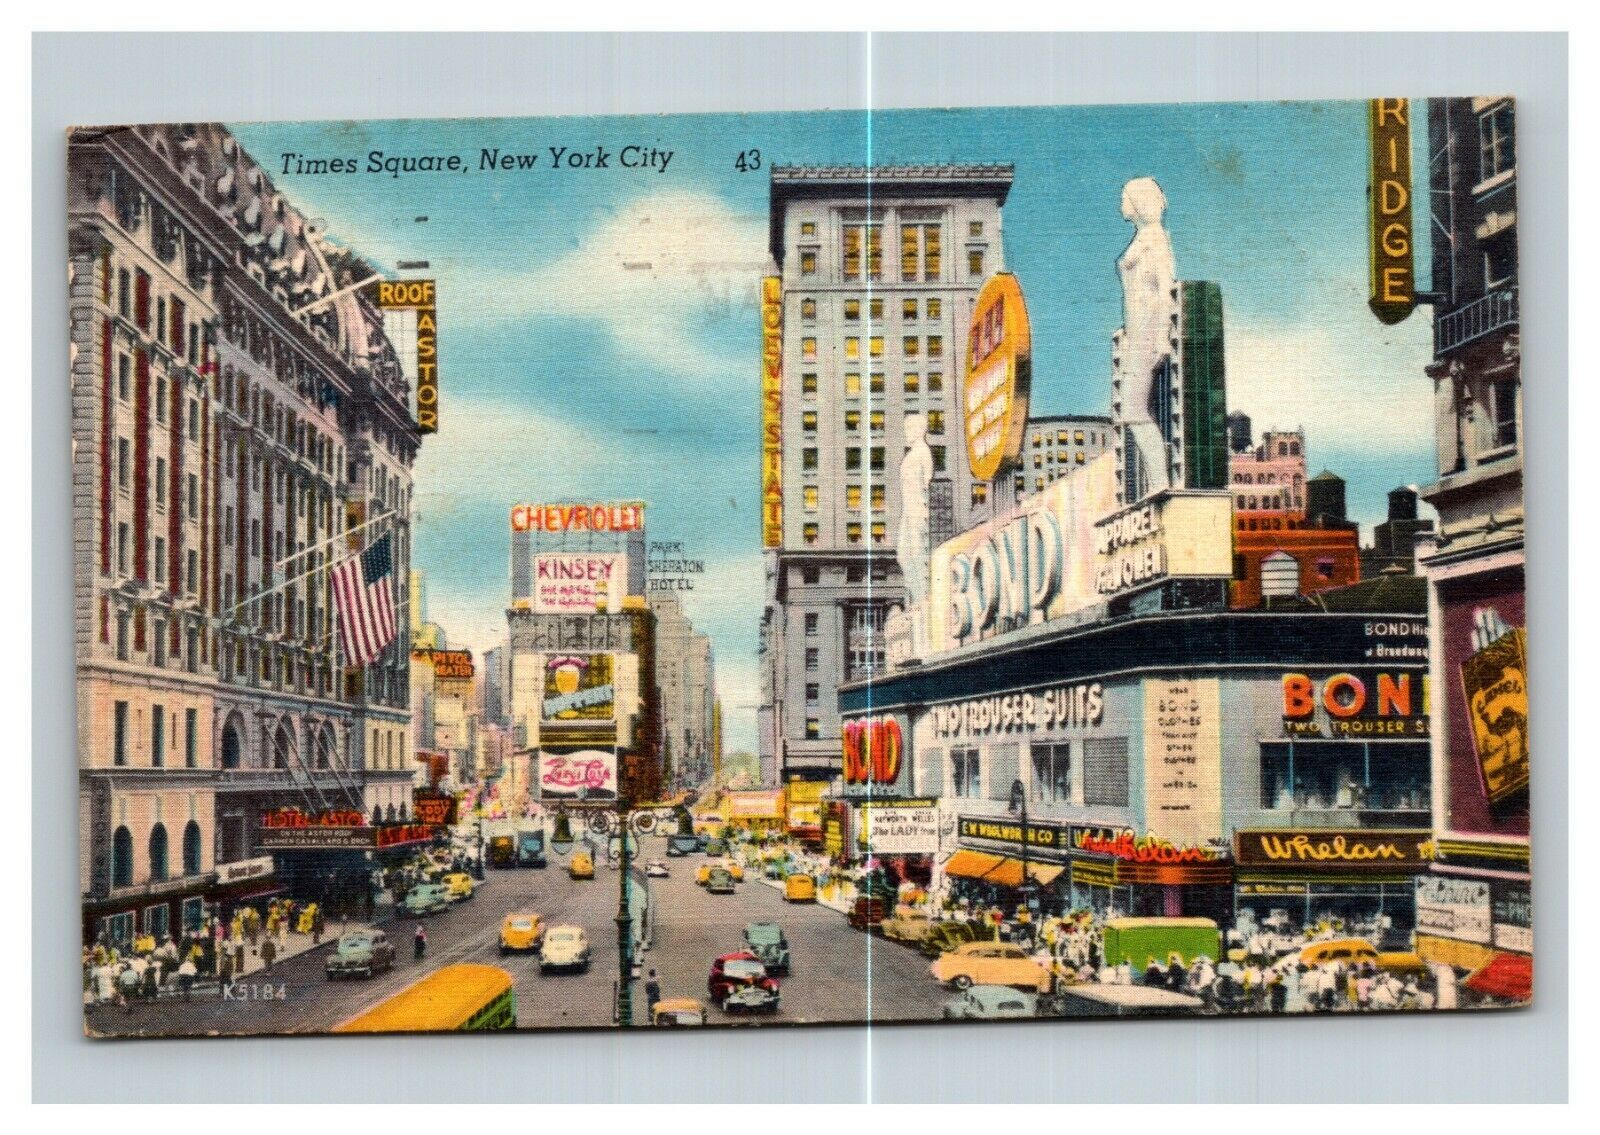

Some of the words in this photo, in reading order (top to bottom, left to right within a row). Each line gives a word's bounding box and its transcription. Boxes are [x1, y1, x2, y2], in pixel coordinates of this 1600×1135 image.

[1377, 97, 1409, 303] RIDGE
[380, 282, 434, 303] ROOF
[417, 313, 438, 429] ASTOR
[510, 501, 645, 532] CHEVROLET
[537, 558, 615, 581] KINSEY
[948, 510, 1063, 642] BOND
[650, 578, 694, 591] HOTEL
[1364, 622, 1410, 636] BOND
[1043, 682, 1104, 731] SUITS
[1282, 672, 1431, 718] BON
[1284, 721, 1321, 733] TWO
[1331, 720, 1405, 733] TROUSER
[841, 714, 904, 785] BOND
[890, 821, 919, 836] LADY
[979, 822, 1036, 842] WOOLWORH
[1260, 835, 1406, 861] Whelan
